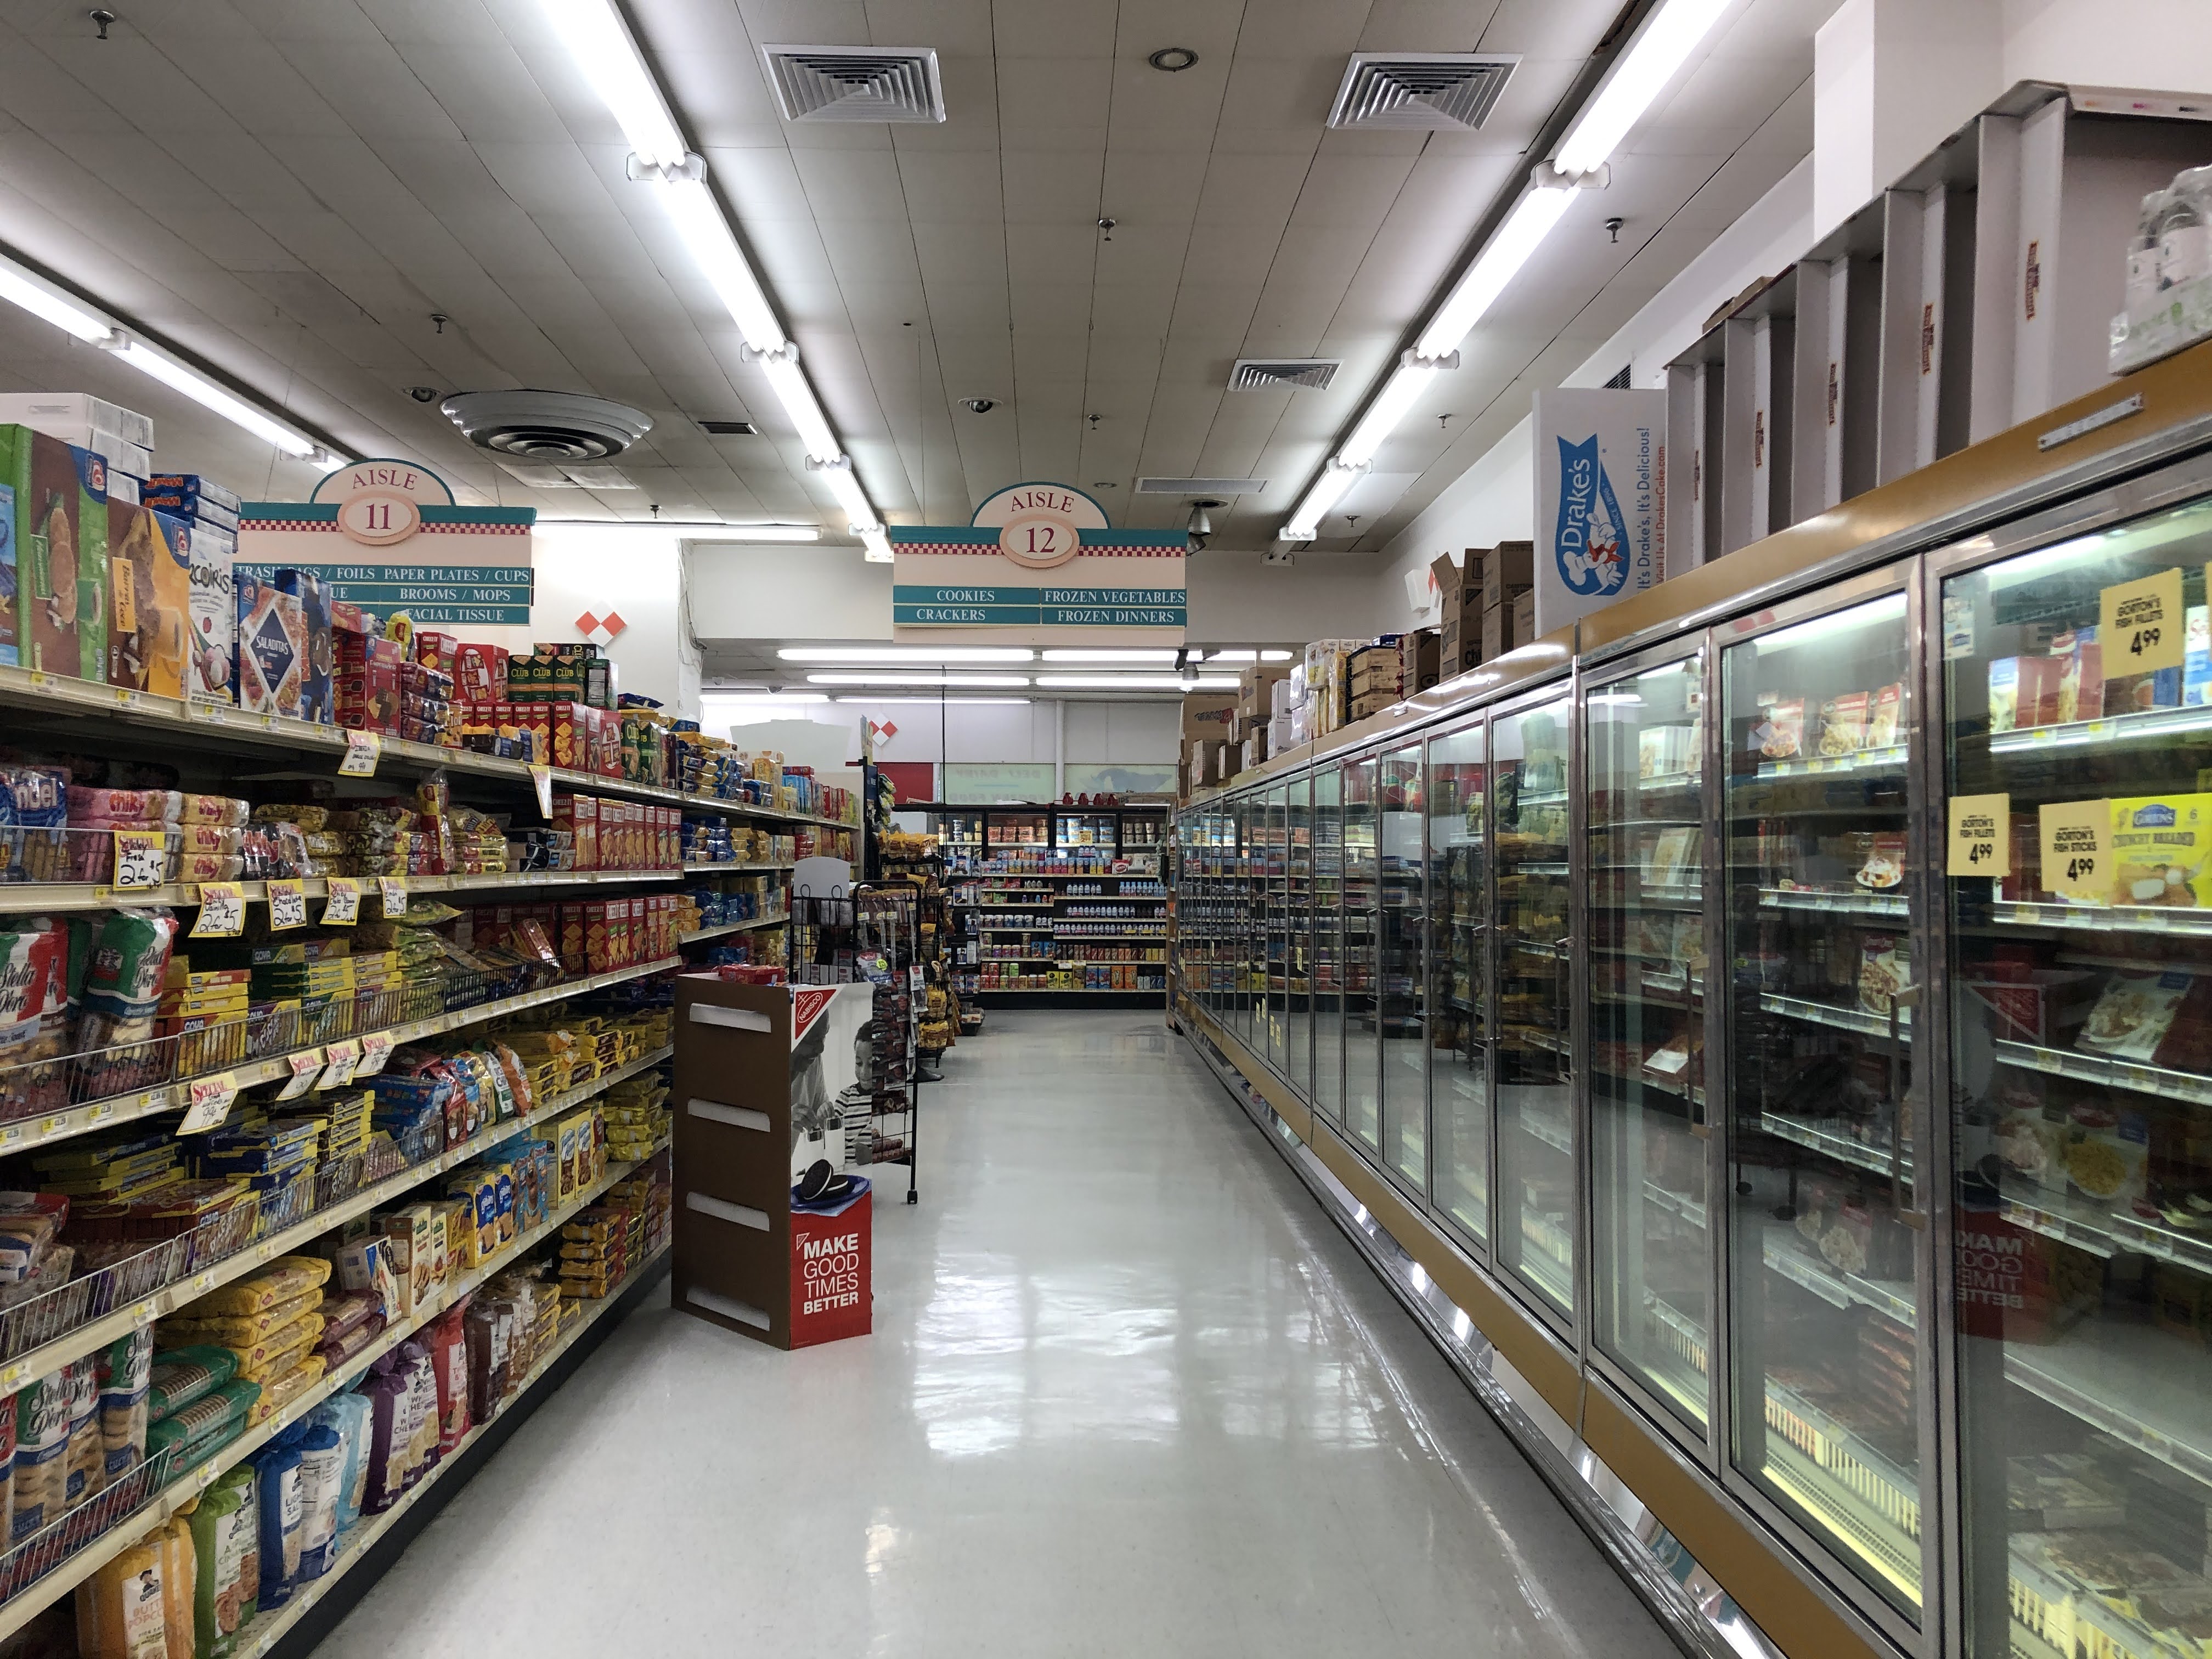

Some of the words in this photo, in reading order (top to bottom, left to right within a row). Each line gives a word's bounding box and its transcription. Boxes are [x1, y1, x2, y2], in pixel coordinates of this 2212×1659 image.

[1637, 428, 1650, 490] Delicious!
[352, 469, 417, 490] AISLE
[1655, 447, 1665, 530] DrakesCake.com
[1011, 492, 1075, 513] AISLE
[1561, 458, 1590, 548] Drake's
[1637, 495, 1650, 512] It's
[365, 504, 391, 529] 11
[1611, 508, 1623, 529] SINCE
[1026, 527, 1056, 553] 12
[1637, 517, 1651, 567] Drake's,
[1656, 533, 1665, 544] At
[337, 568, 375, 579] FOILS
[384, 568, 427, 580] PAPER
[431, 569, 479, 581] PLATES
[494, 570, 529, 582] CUPS
[1637, 572, 1651, 589] It's
[1656, 562, 1665, 583] Visit
[399, 588, 456, 600] BROOMS
[472, 589, 511, 601] MOPS
[936, 590, 995, 602] COOKIES
[1045, 591, 1097, 603] FROZEN
[1102, 591, 1185, 604] VEGETABLES
[405, 608, 453, 620] FACIAL
[458, 609, 504, 621] TISSUE
[916, 608, 986, 620] CRACKERS
[1058, 611, 1110, 623] FROZEN
[1115, 611, 1175, 623] DINNERS
[256, 635, 289, 655] SALADITAS
[511, 668, 529, 678] CLUB
[533, 668, 551, 678] CLUB
[556, 668, 574, 678] CLUB
[2055, 830, 2095, 842] GORTON'S
[2071, 842, 2097, 852] STICKS
[120, 865, 136, 885] 2
[274, 908, 285, 926] 2
[386, 899, 393, 915] 2
[199, 913, 213, 932] 2
[224, 909, 239, 930] $5
[0, 962, 36, 989] Stella
[798, 994, 821, 1021] NABISCO
[184, 1019, 204, 1032] GOYA
[804, 1233, 859, 1260] MAKE
[804, 1252, 859, 1279] GOOD
[804, 1272, 859, 1299] TIMES
[804, 1291, 859, 1315] BETTER
